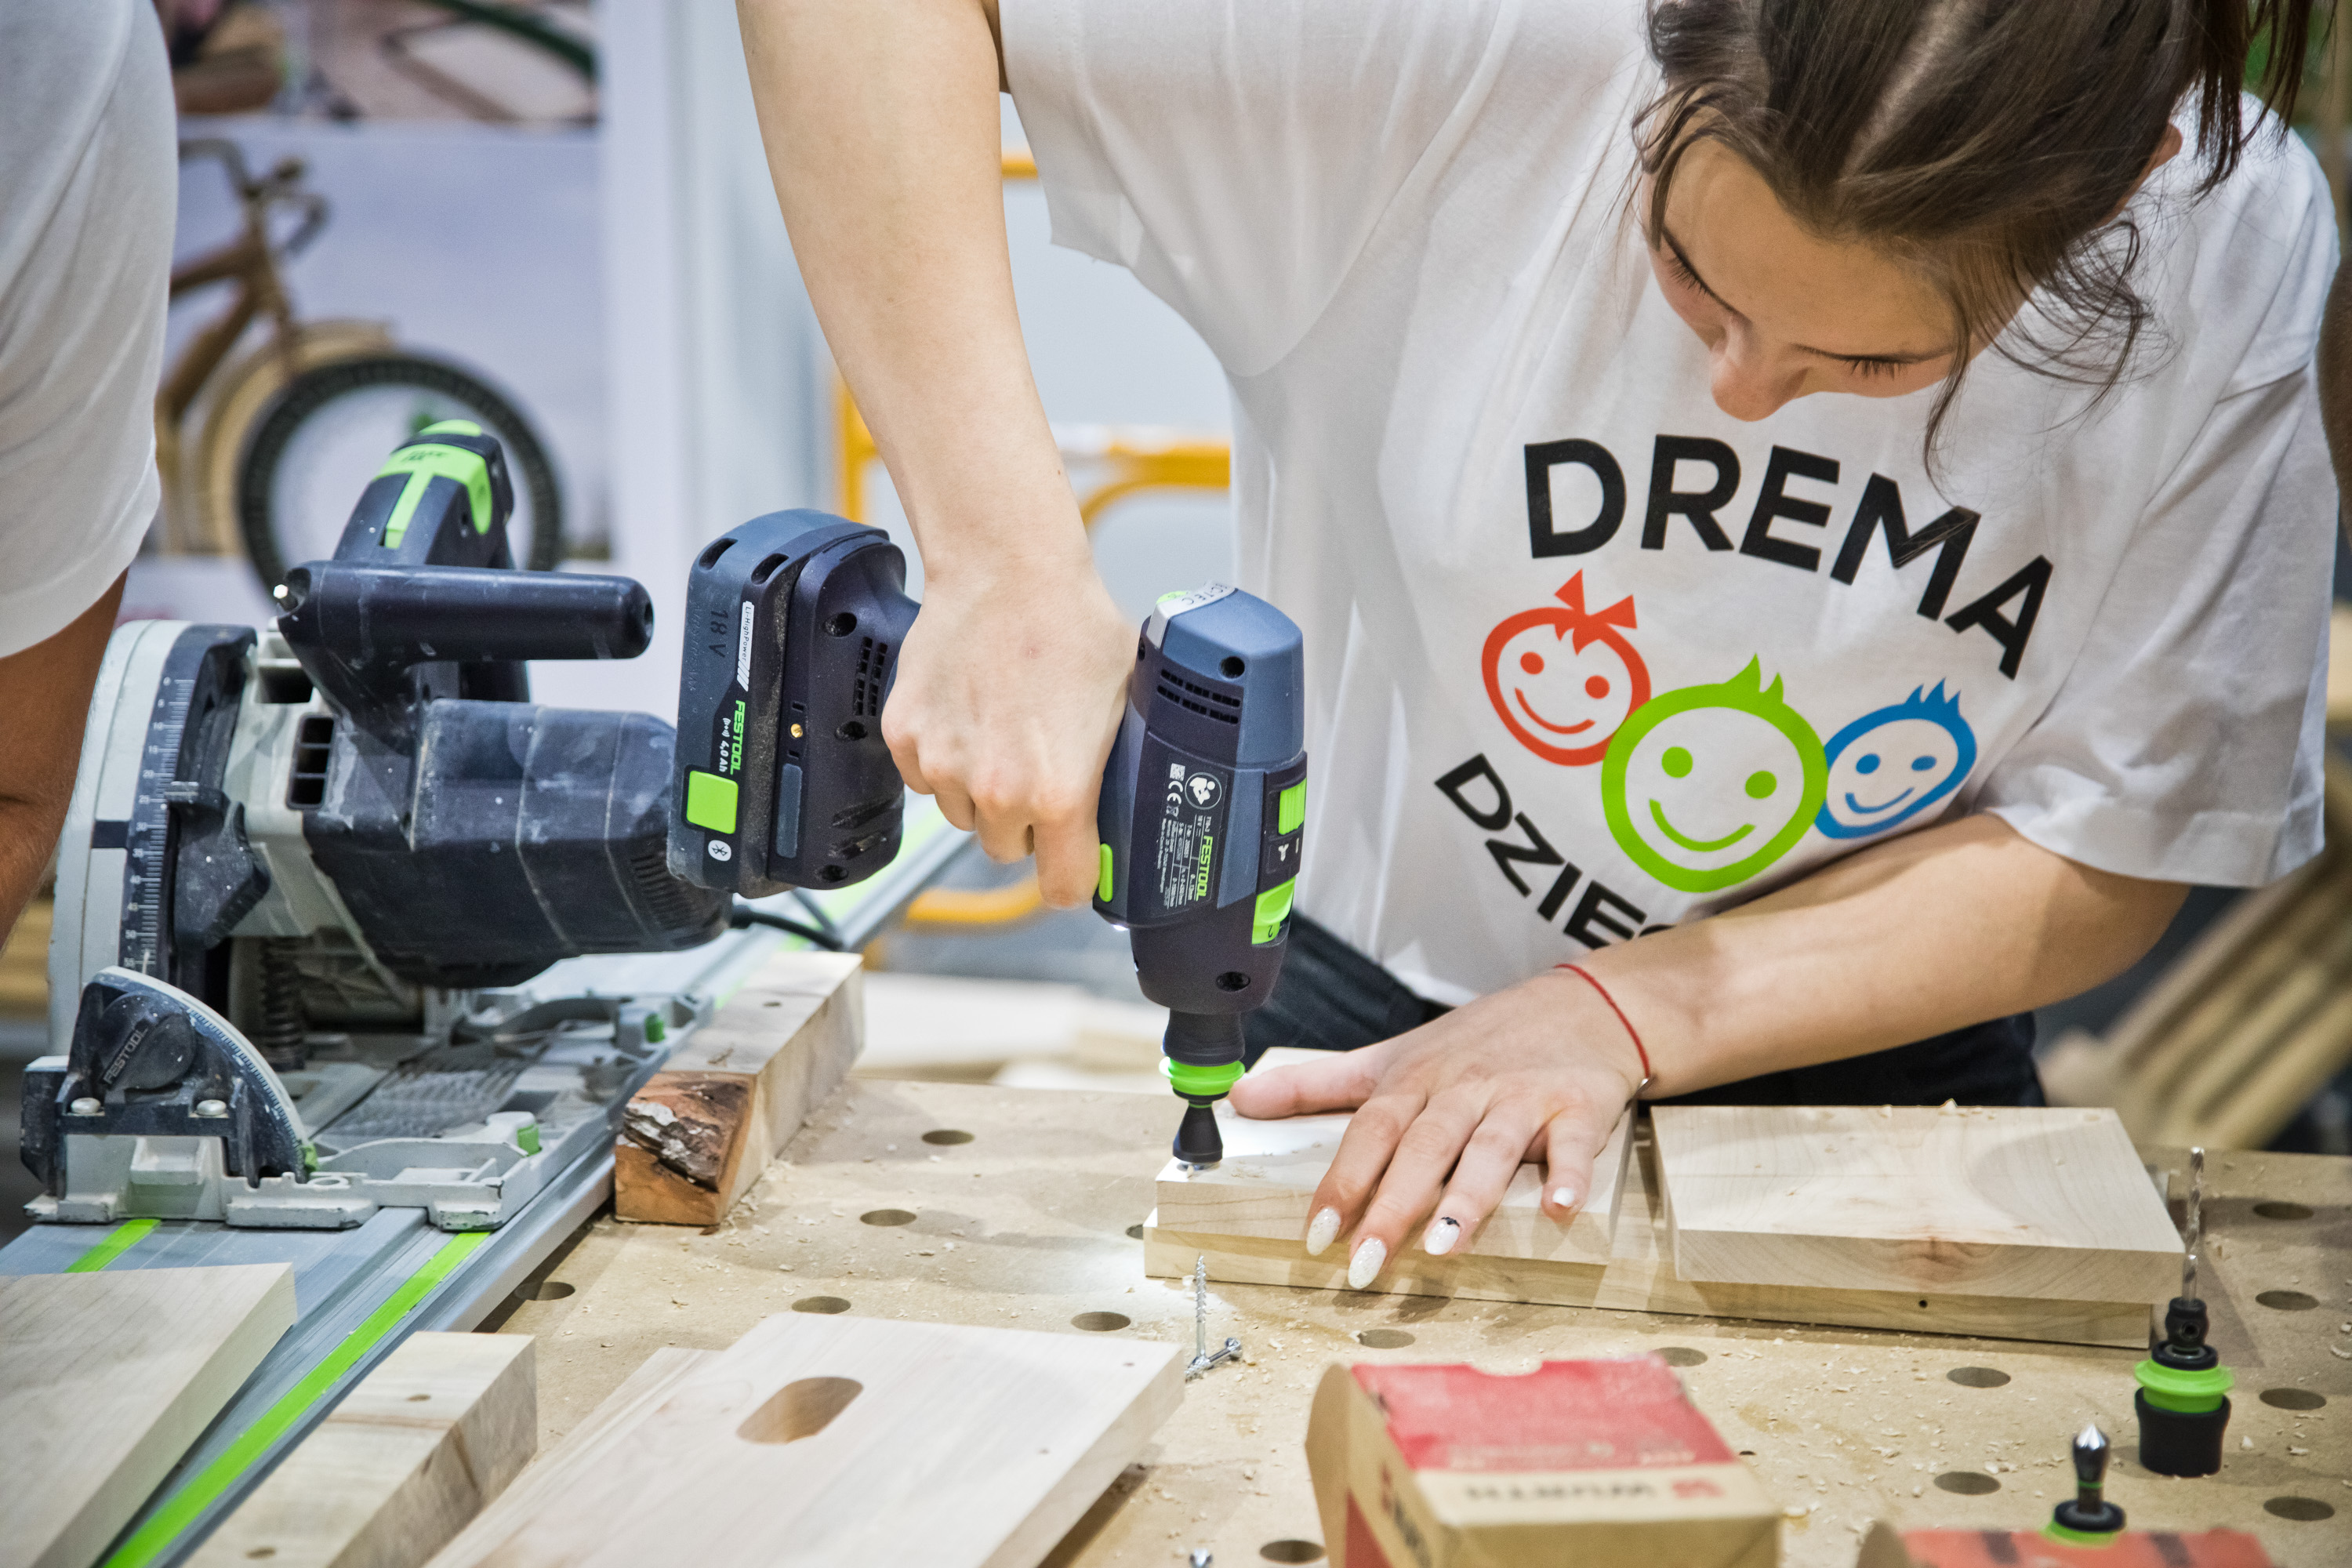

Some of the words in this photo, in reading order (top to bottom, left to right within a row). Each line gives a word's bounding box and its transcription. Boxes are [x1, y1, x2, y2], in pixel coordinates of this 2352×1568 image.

[1524, 434, 2054, 681] DREMA
[710, 609, 729, 636] 18
[742, 605, 752, 662] Li-HighPower
[708, 644, 727, 659] V
[153, 721, 165, 731] 10
[730, 699, 746, 775] FESTOOL
[148, 745, 159, 755] 15
[718, 758, 728, 773] Ah
[143, 769, 154, 779] 20
[138, 794, 151, 805] 25
[136, 822, 148, 832] 30
[1433, 753, 1679, 951] DZIE
[1195, 835, 1214, 902] FESTOOL
[125, 930, 137, 939] 50
[103, 1026, 149, 1086] FESTOOL
